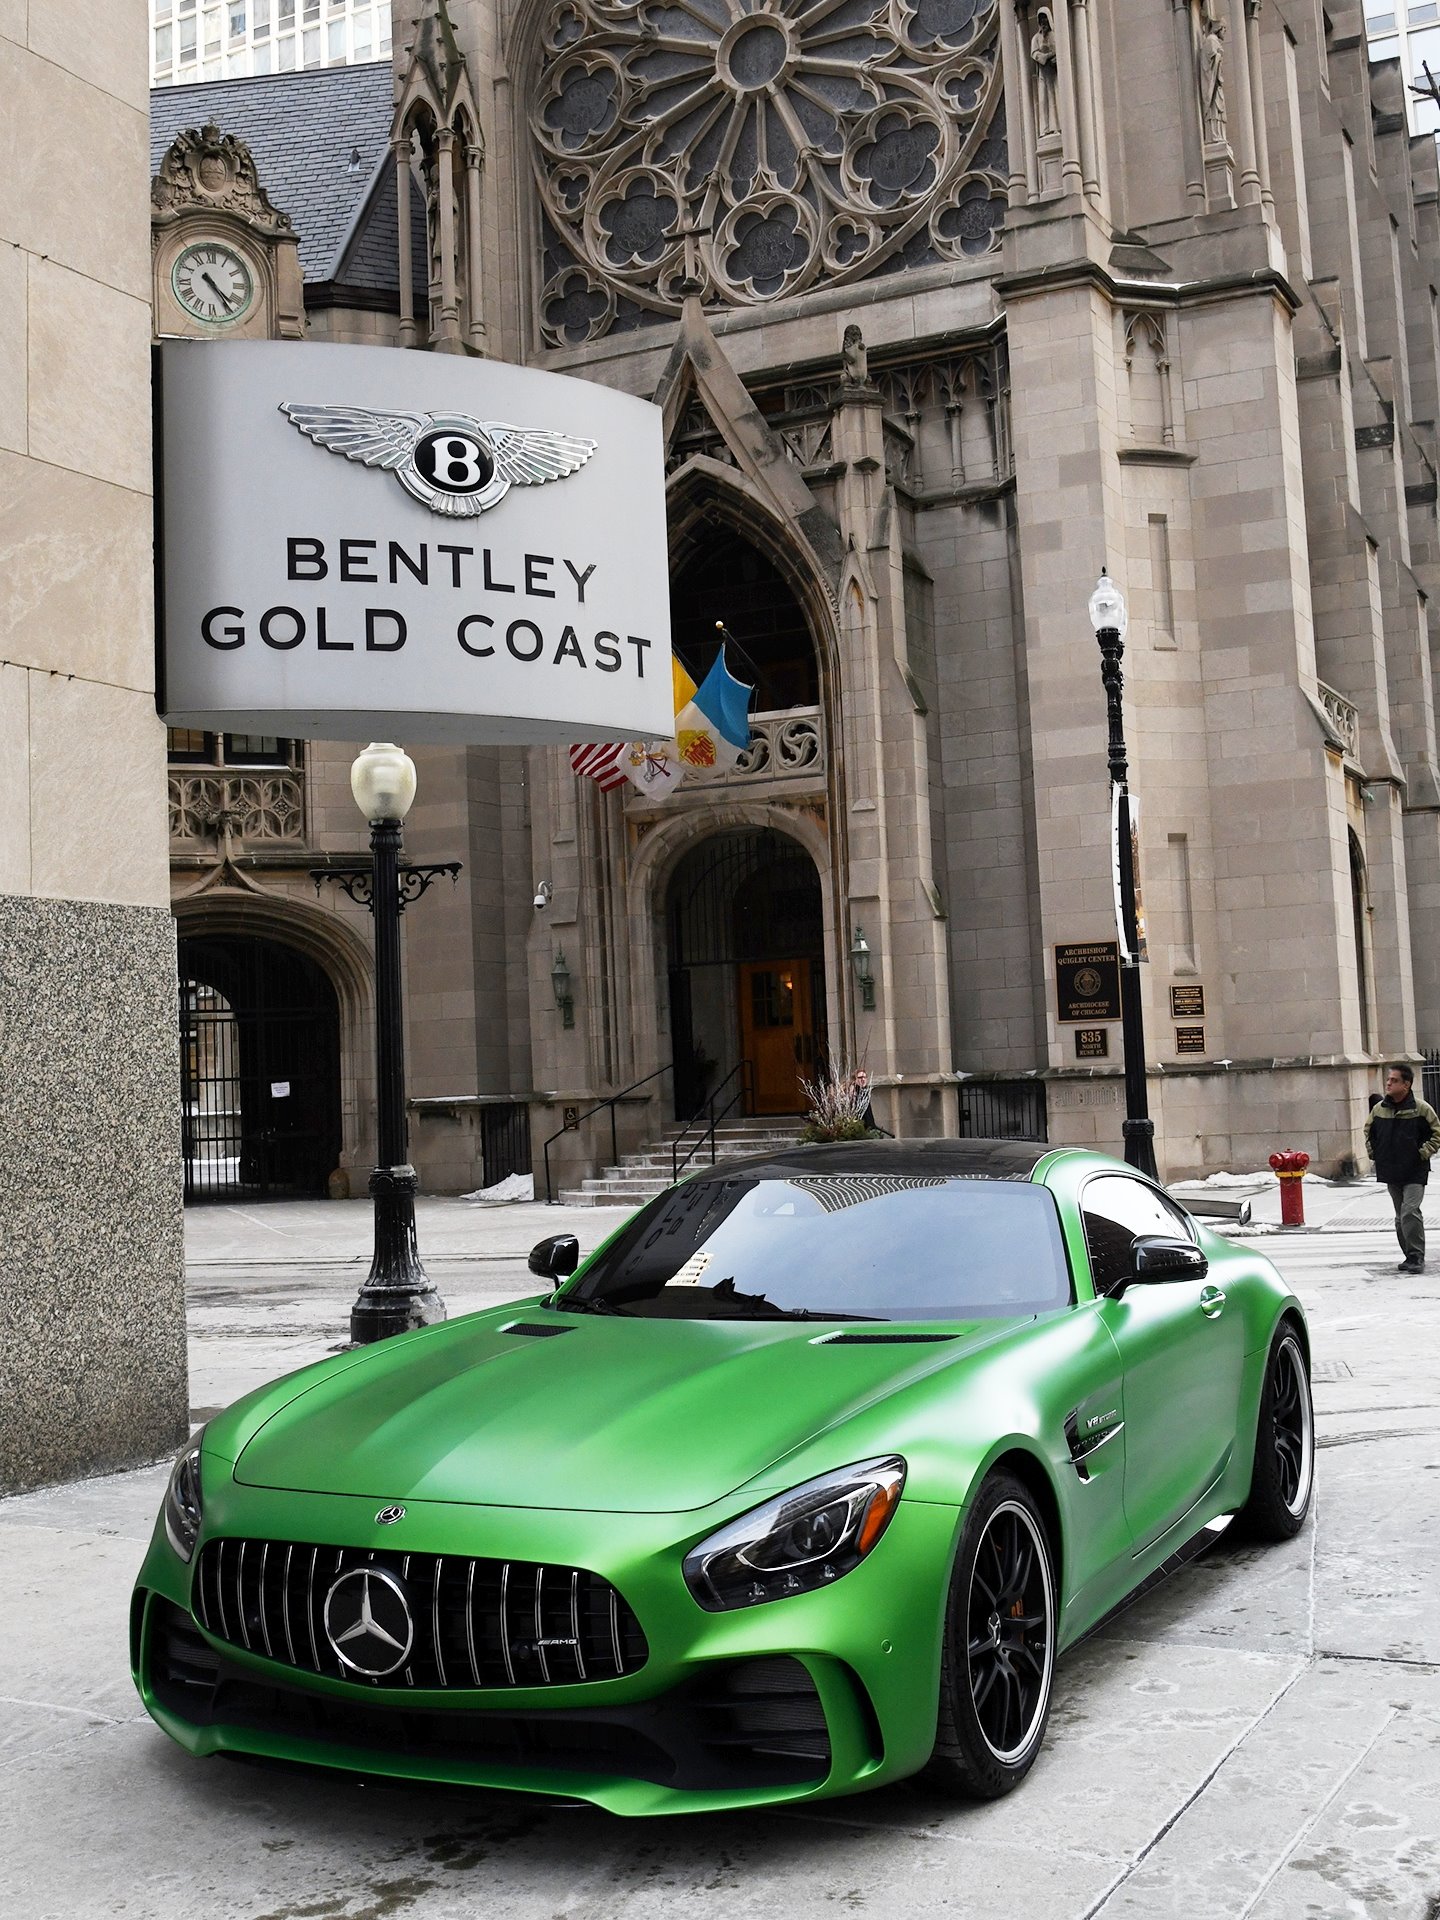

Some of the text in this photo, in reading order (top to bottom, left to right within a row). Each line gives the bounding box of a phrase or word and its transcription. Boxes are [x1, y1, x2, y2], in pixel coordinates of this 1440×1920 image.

[431, 435, 482, 487] B
[286, 537, 597, 603] BENTLEY
[200, 605, 652, 679] GOLD COAST
[1064, 947, 1108, 956] ARCHBISHOP
[1057, 955, 1116, 965] QUIGLEY CENTER
[1068, 1001, 1110, 1009] ARCHDIOCESE
[1080, 1008, 1107, 1016] CHICAGO
[1080, 1031, 1101, 1043] 835
